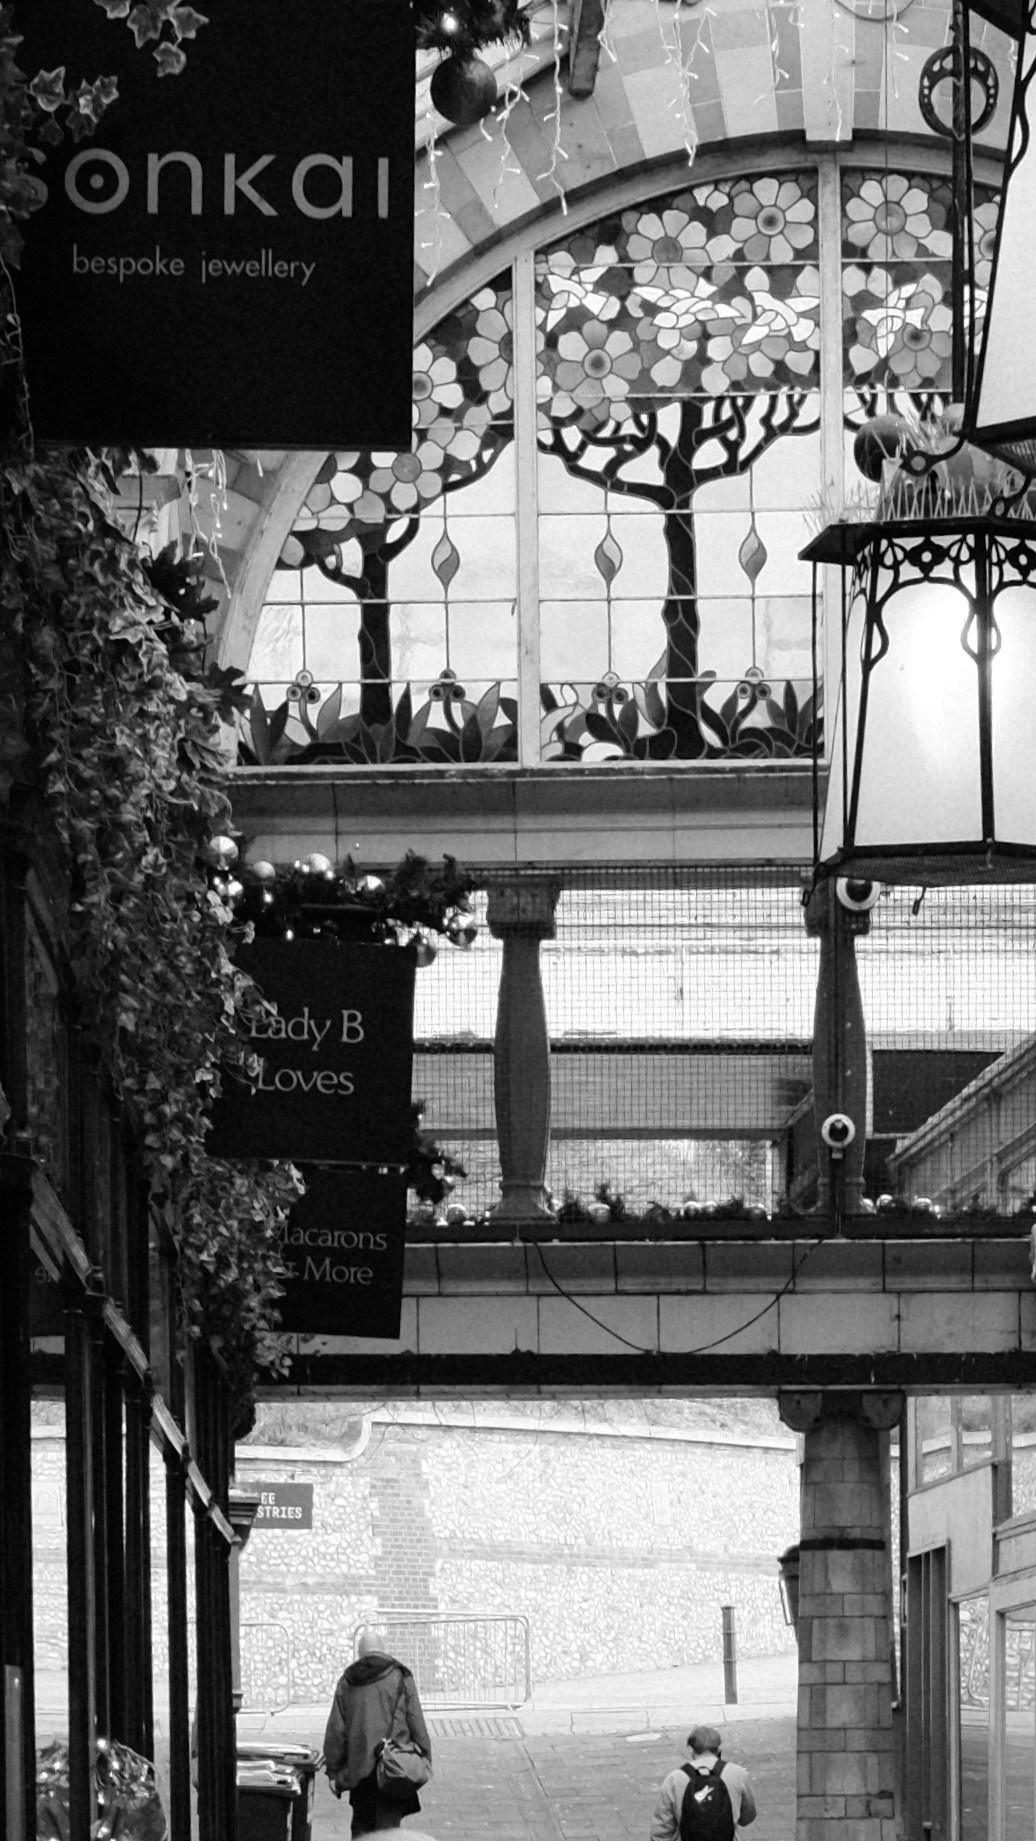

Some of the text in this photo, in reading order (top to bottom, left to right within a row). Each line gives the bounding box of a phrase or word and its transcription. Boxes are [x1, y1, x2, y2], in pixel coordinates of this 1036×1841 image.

[73, 243, 316, 286] bespoke jewellery
[252, 1007, 365, 1051] Lady B
[257, 1059, 355, 1095] Loves
[304, 1256, 374, 1286] More
